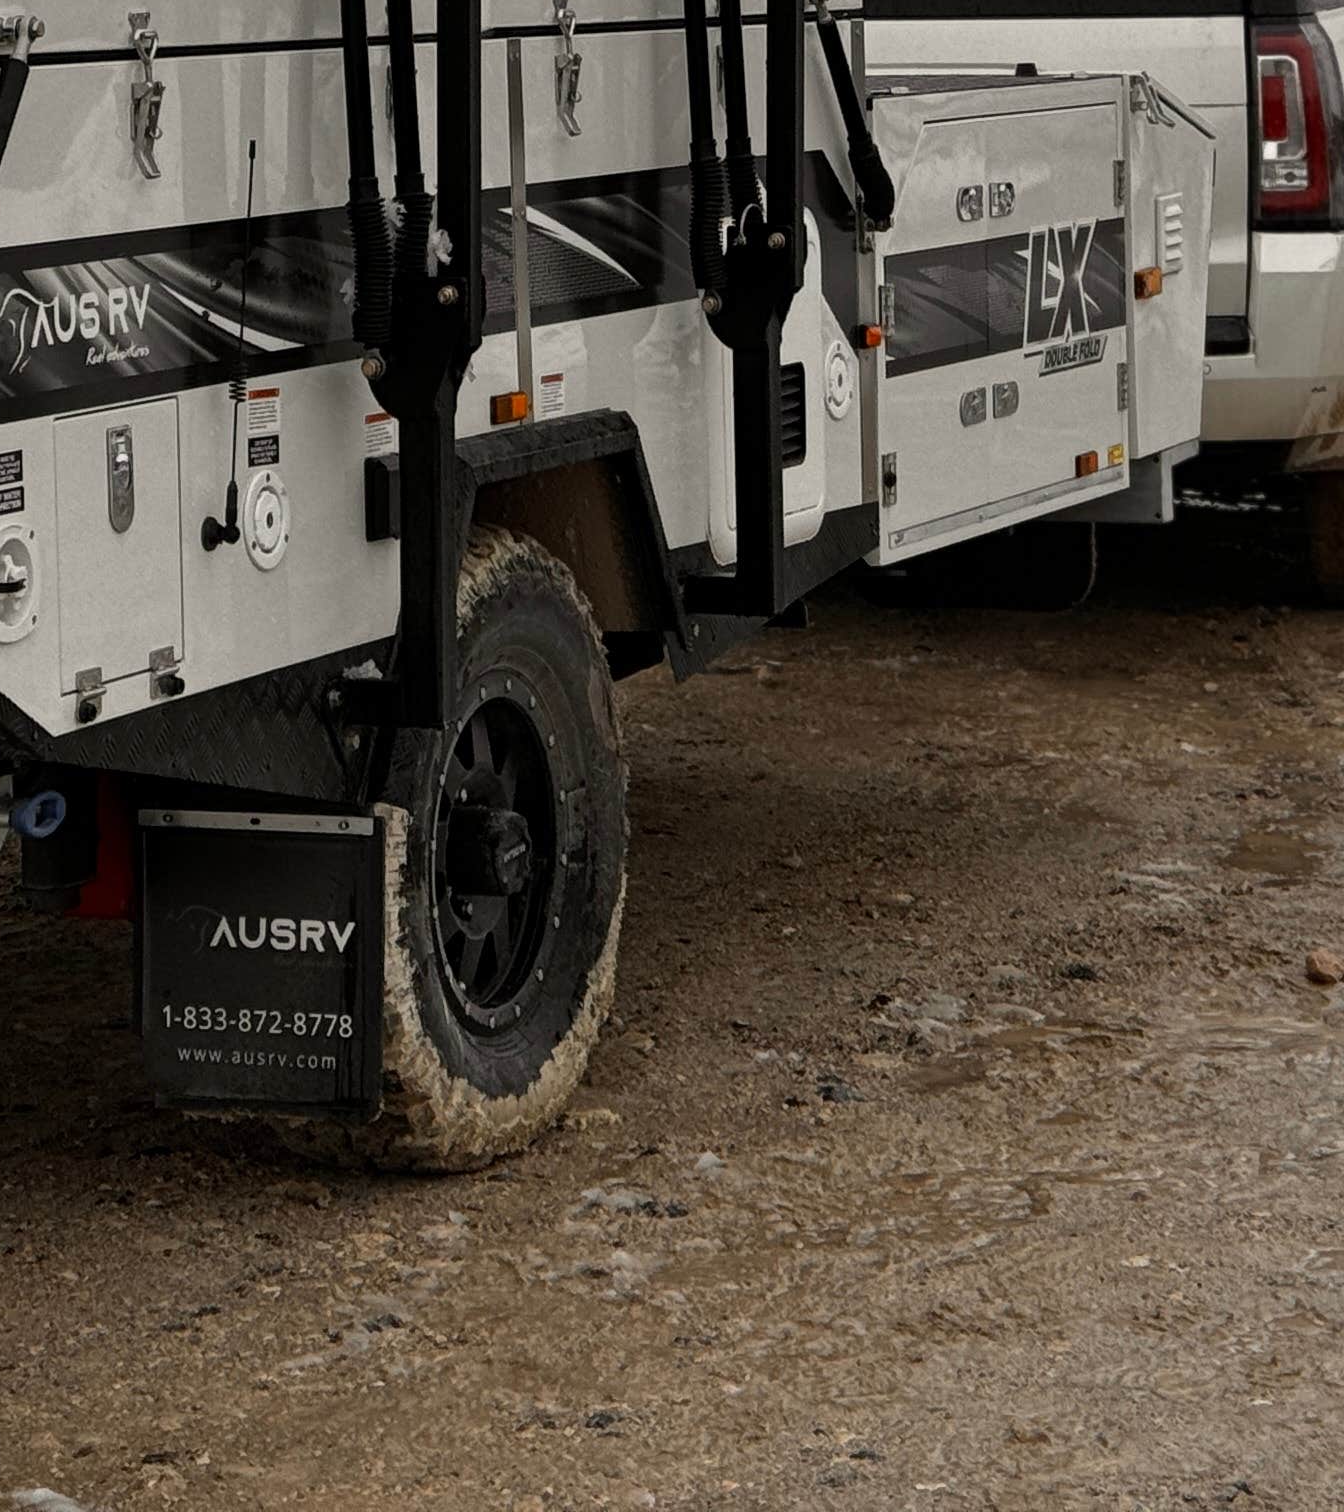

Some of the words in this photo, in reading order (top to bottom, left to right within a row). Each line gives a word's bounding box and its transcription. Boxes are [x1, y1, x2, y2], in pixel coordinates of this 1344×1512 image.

[1023, 218, 1098, 350] LX
[209, 915, 356, 953] AUSRV
[161, 1004, 354, 1038] 1-833-872-8778
[178, 1047, 337, 1070] www.ausrv.com
